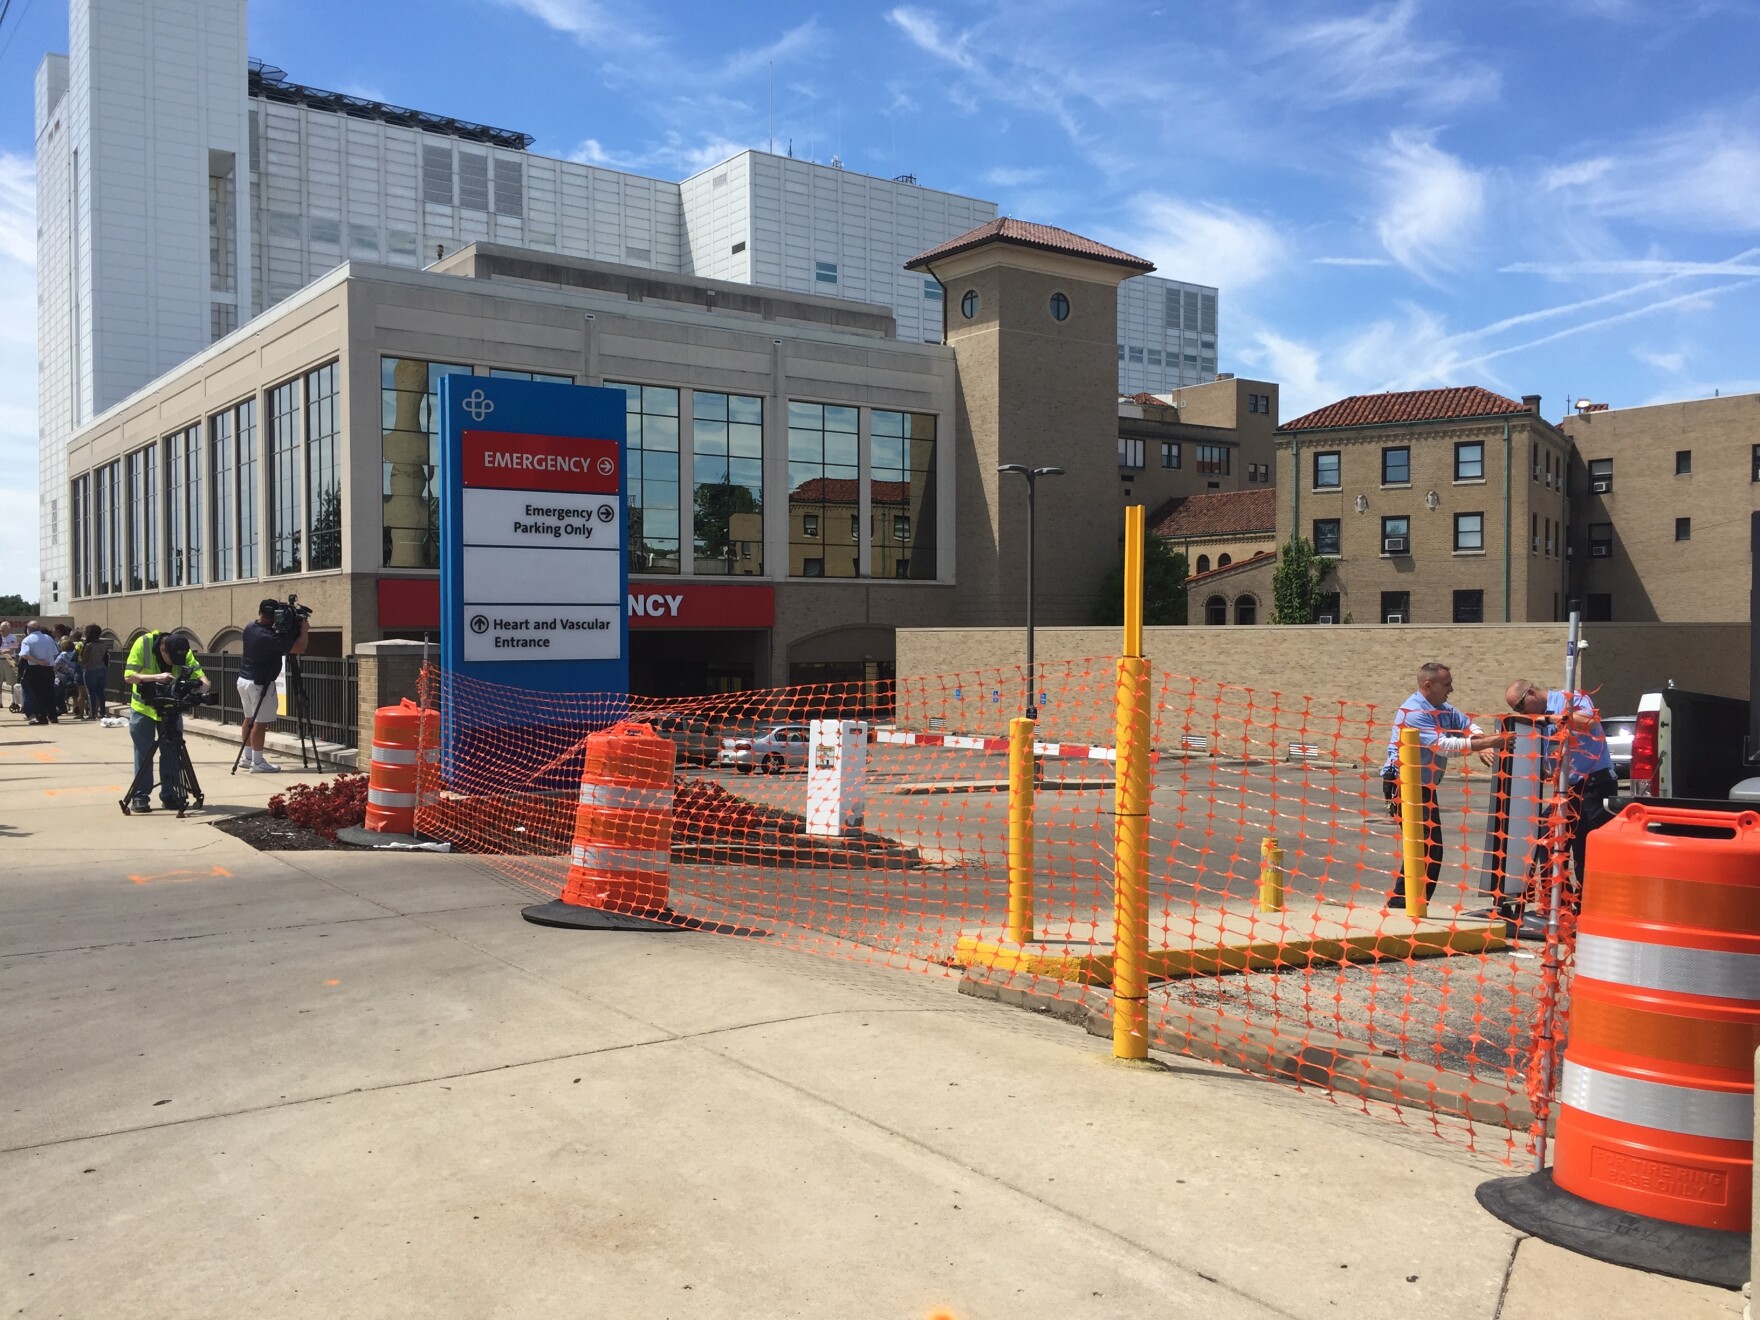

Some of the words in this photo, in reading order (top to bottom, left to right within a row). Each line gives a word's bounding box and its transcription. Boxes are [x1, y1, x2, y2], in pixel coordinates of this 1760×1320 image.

[484, 451, 591, 472] EMERGENCY
[525, 504, 593, 521] Emergency
[514, 521, 562, 538] Parking
[564, 523, 593, 539] Only
[493, 618, 530, 631] Heart
[533, 618, 557, 630] and
[560, 618, 611, 631] Vascular
[494, 636, 550, 648] Entrance
[1597, 1151, 1626, 1168] FOR
[1631, 1158, 1671, 1178] TIRE
[1677, 1167, 1722, 1186] RING
[1608, 1168, 1650, 1190] BASE
[1657, 1179, 1705, 1199] ONLY
